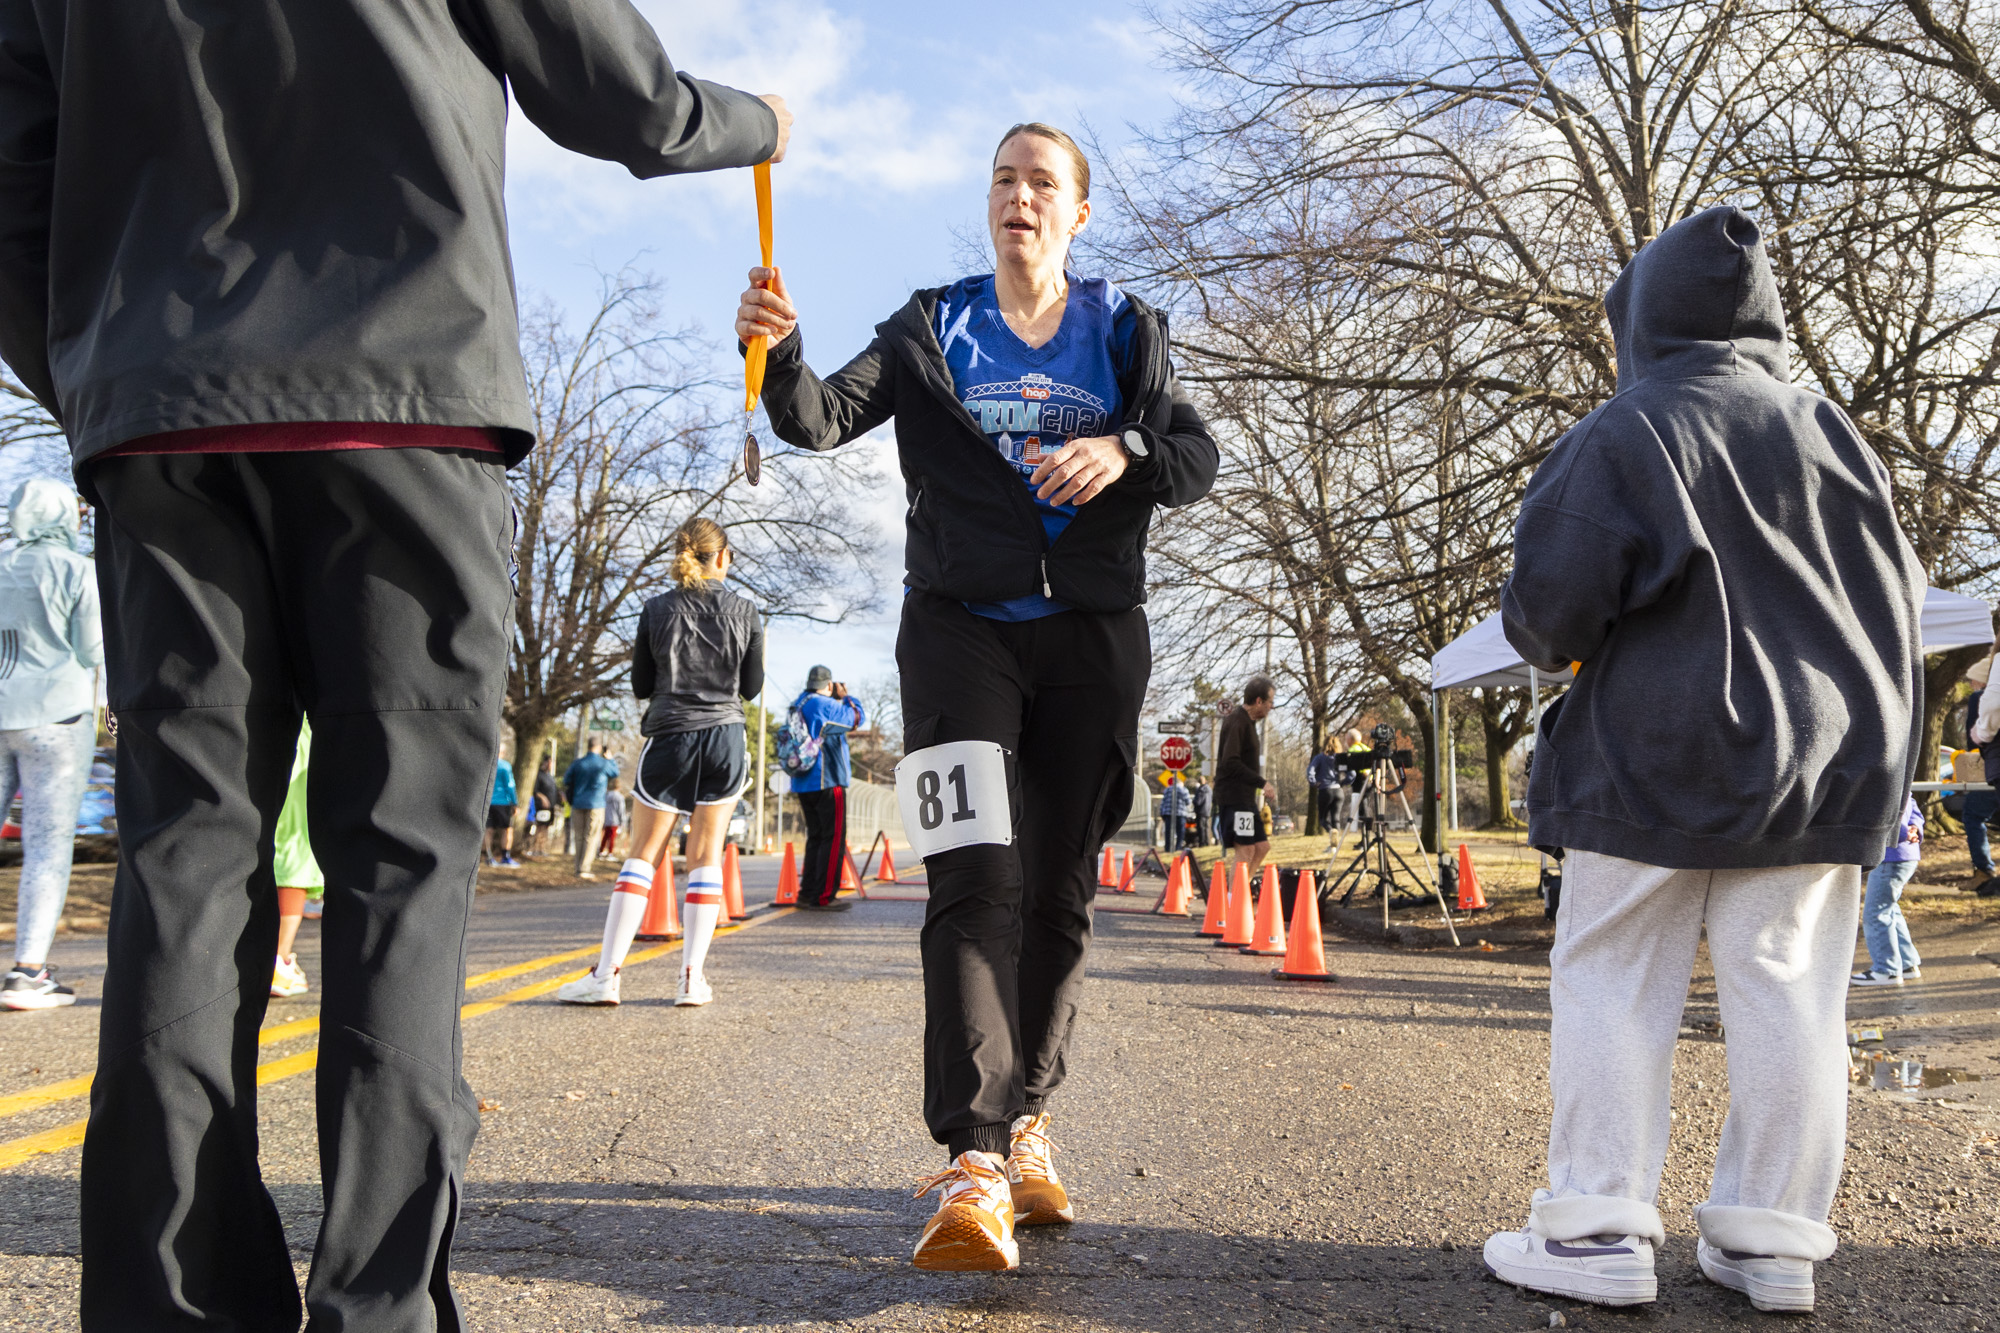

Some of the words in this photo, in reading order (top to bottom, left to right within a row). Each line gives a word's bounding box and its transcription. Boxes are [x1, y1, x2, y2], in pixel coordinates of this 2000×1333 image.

[1042, 403, 1108, 438] 2021
[1161, 746, 1191, 760] STOP
[916, 764, 976, 830] 81
